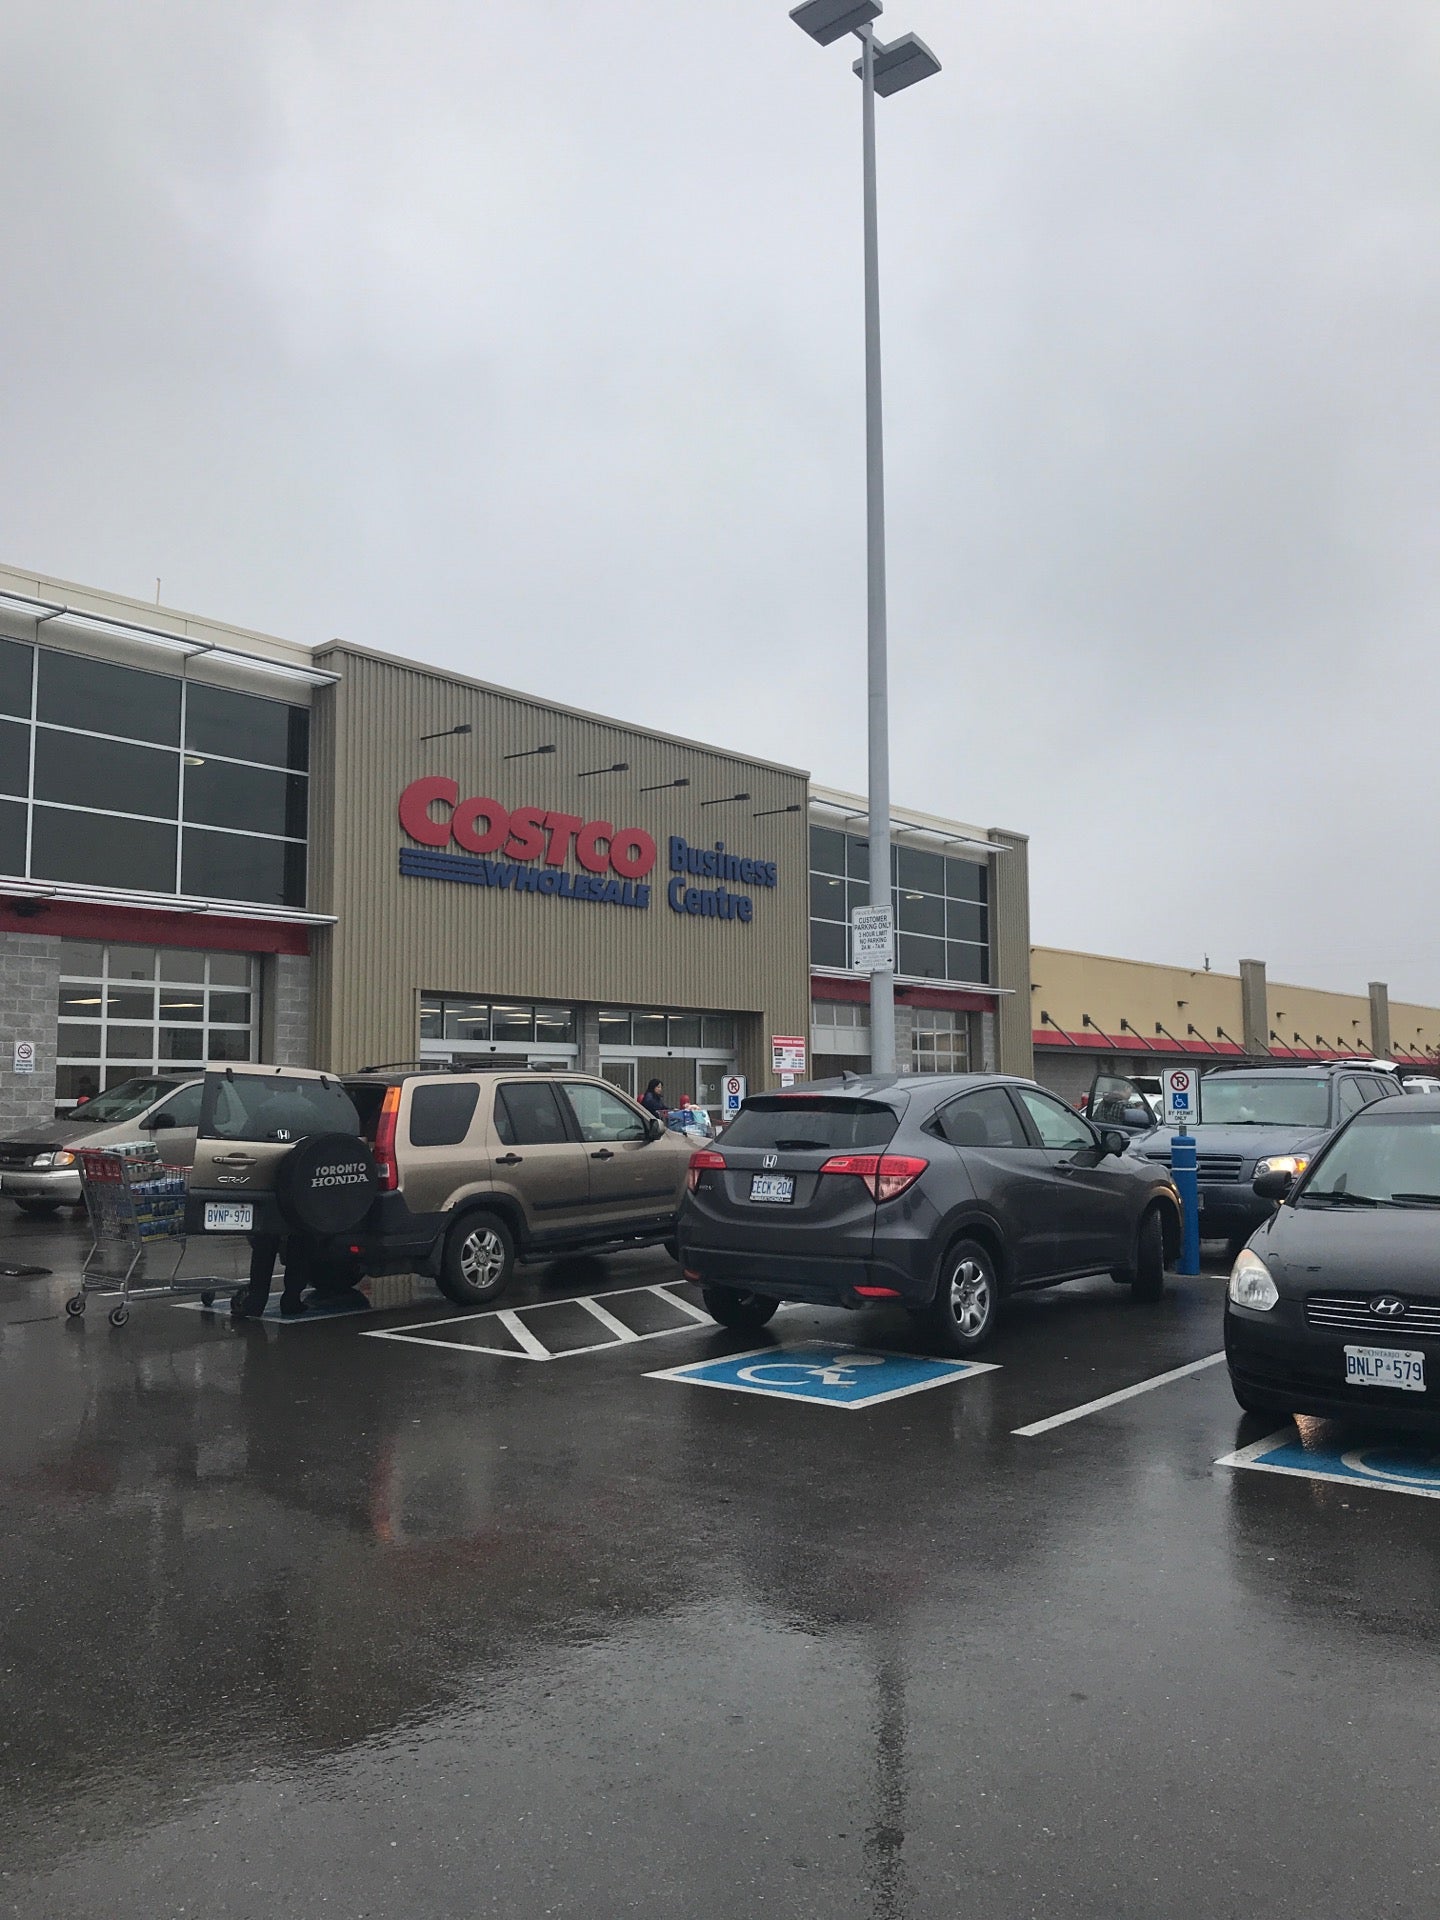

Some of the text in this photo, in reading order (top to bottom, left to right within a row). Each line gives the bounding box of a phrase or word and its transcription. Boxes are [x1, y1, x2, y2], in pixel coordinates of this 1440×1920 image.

[399, 776, 656, 878] COSTCO
[669, 835, 777, 887] Business
[484, 860, 650, 908] WHOLESALE
[668, 877, 752, 922] Centre
[859, 915, 887, 924] CUSTOMER
[315, 1162, 367, 1176] TORONTO
[217, 1176, 251, 1184] CR-V
[311, 1173, 369, 1188] HONDA
[208, 1209, 250, 1222] BVNP 970
[1367, 1349, 1400, 1358] ONTARIO
[1348, 1355, 1421, 1381] BNLP 579
